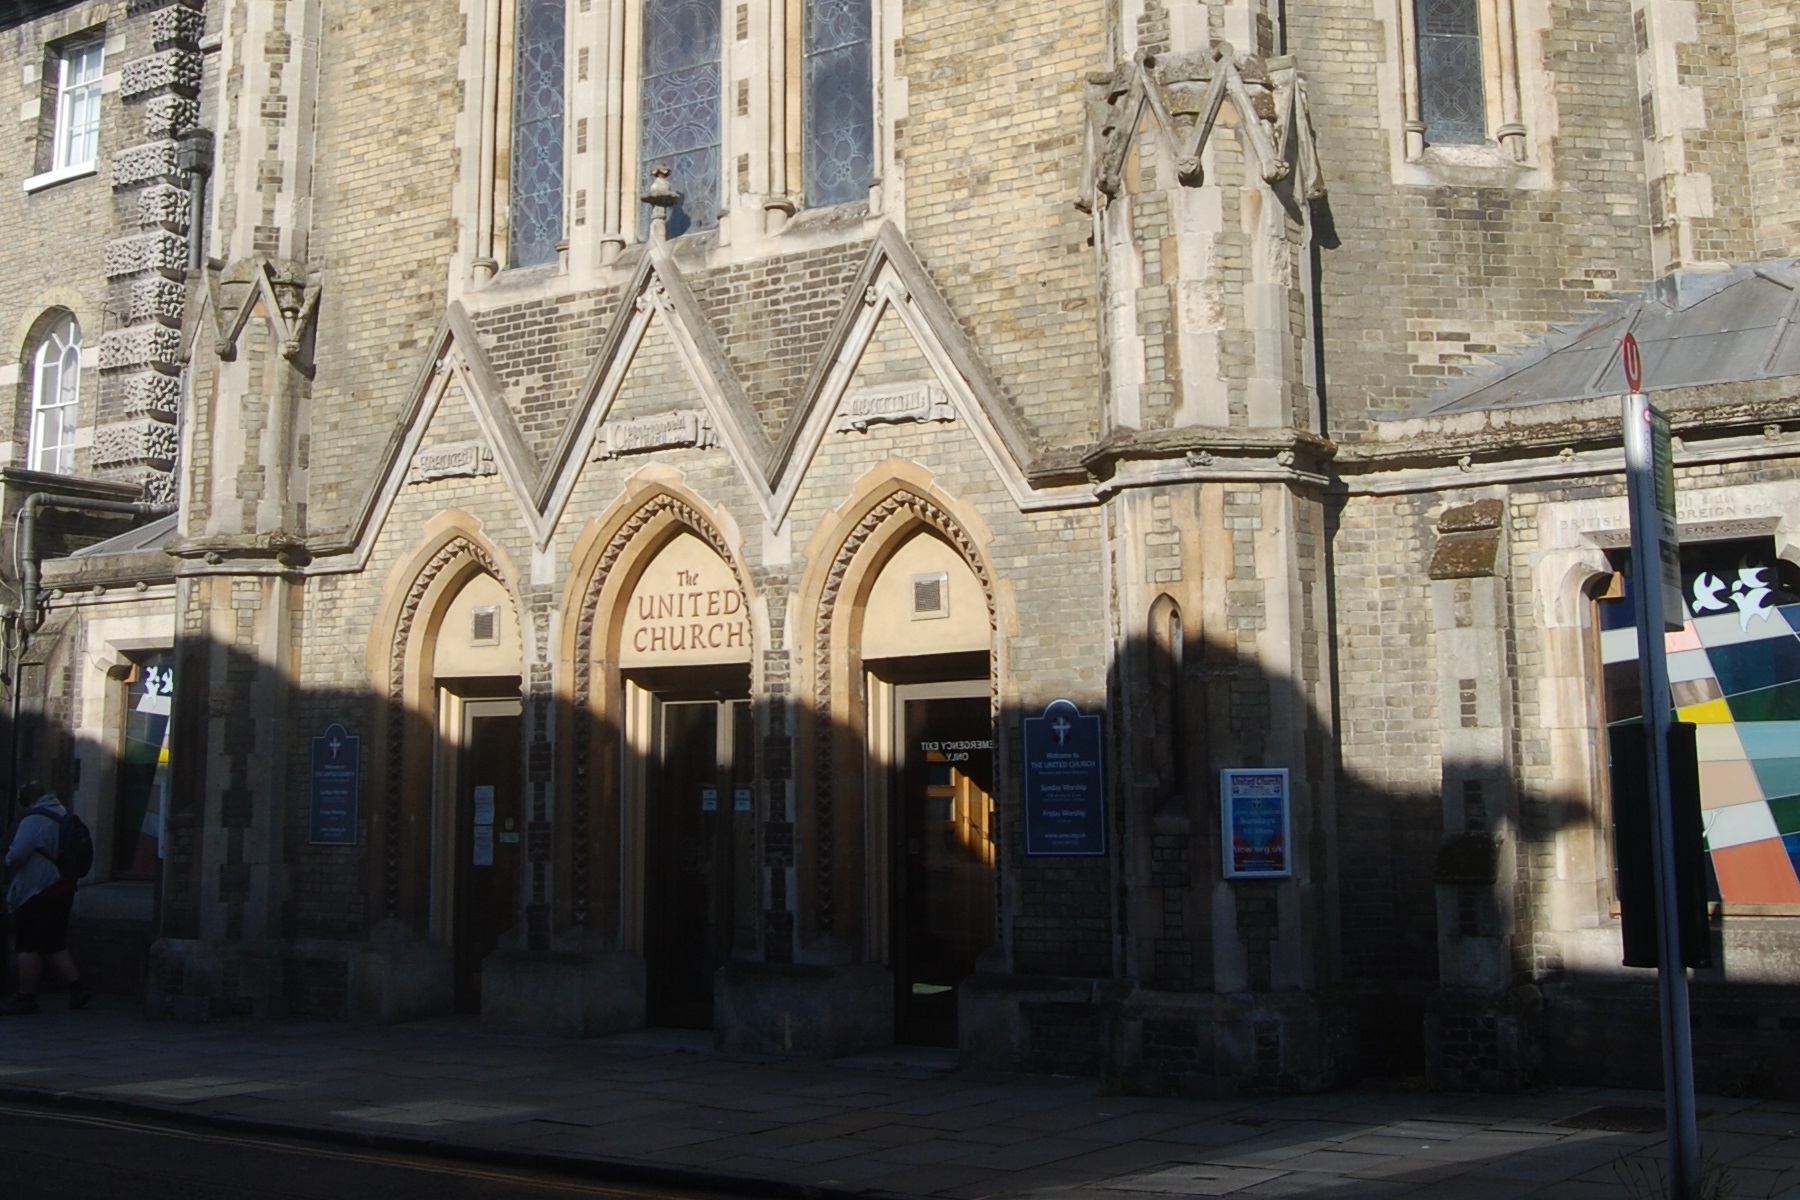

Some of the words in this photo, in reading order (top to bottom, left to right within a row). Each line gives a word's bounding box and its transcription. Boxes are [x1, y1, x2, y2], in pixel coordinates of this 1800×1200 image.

[1626, 342, 1638, 381] U
[1561, 516, 1621, 530] BRITISH
[1677, 505, 1736, 520] OREIGN
[1685, 526, 1715, 536] FOR
[1720, 521, 1768, 532] GIRLS
[676, 569, 699, 587] The
[637, 589, 742, 620] UNITED
[633, 622, 745, 653] CHURCH
[1069, 760, 1096, 768] CHURCH
[1041, 784, 1061, 792] Sunday
[1232, 776, 1255, 785] United
[1043, 810, 1060, 818] Friday
